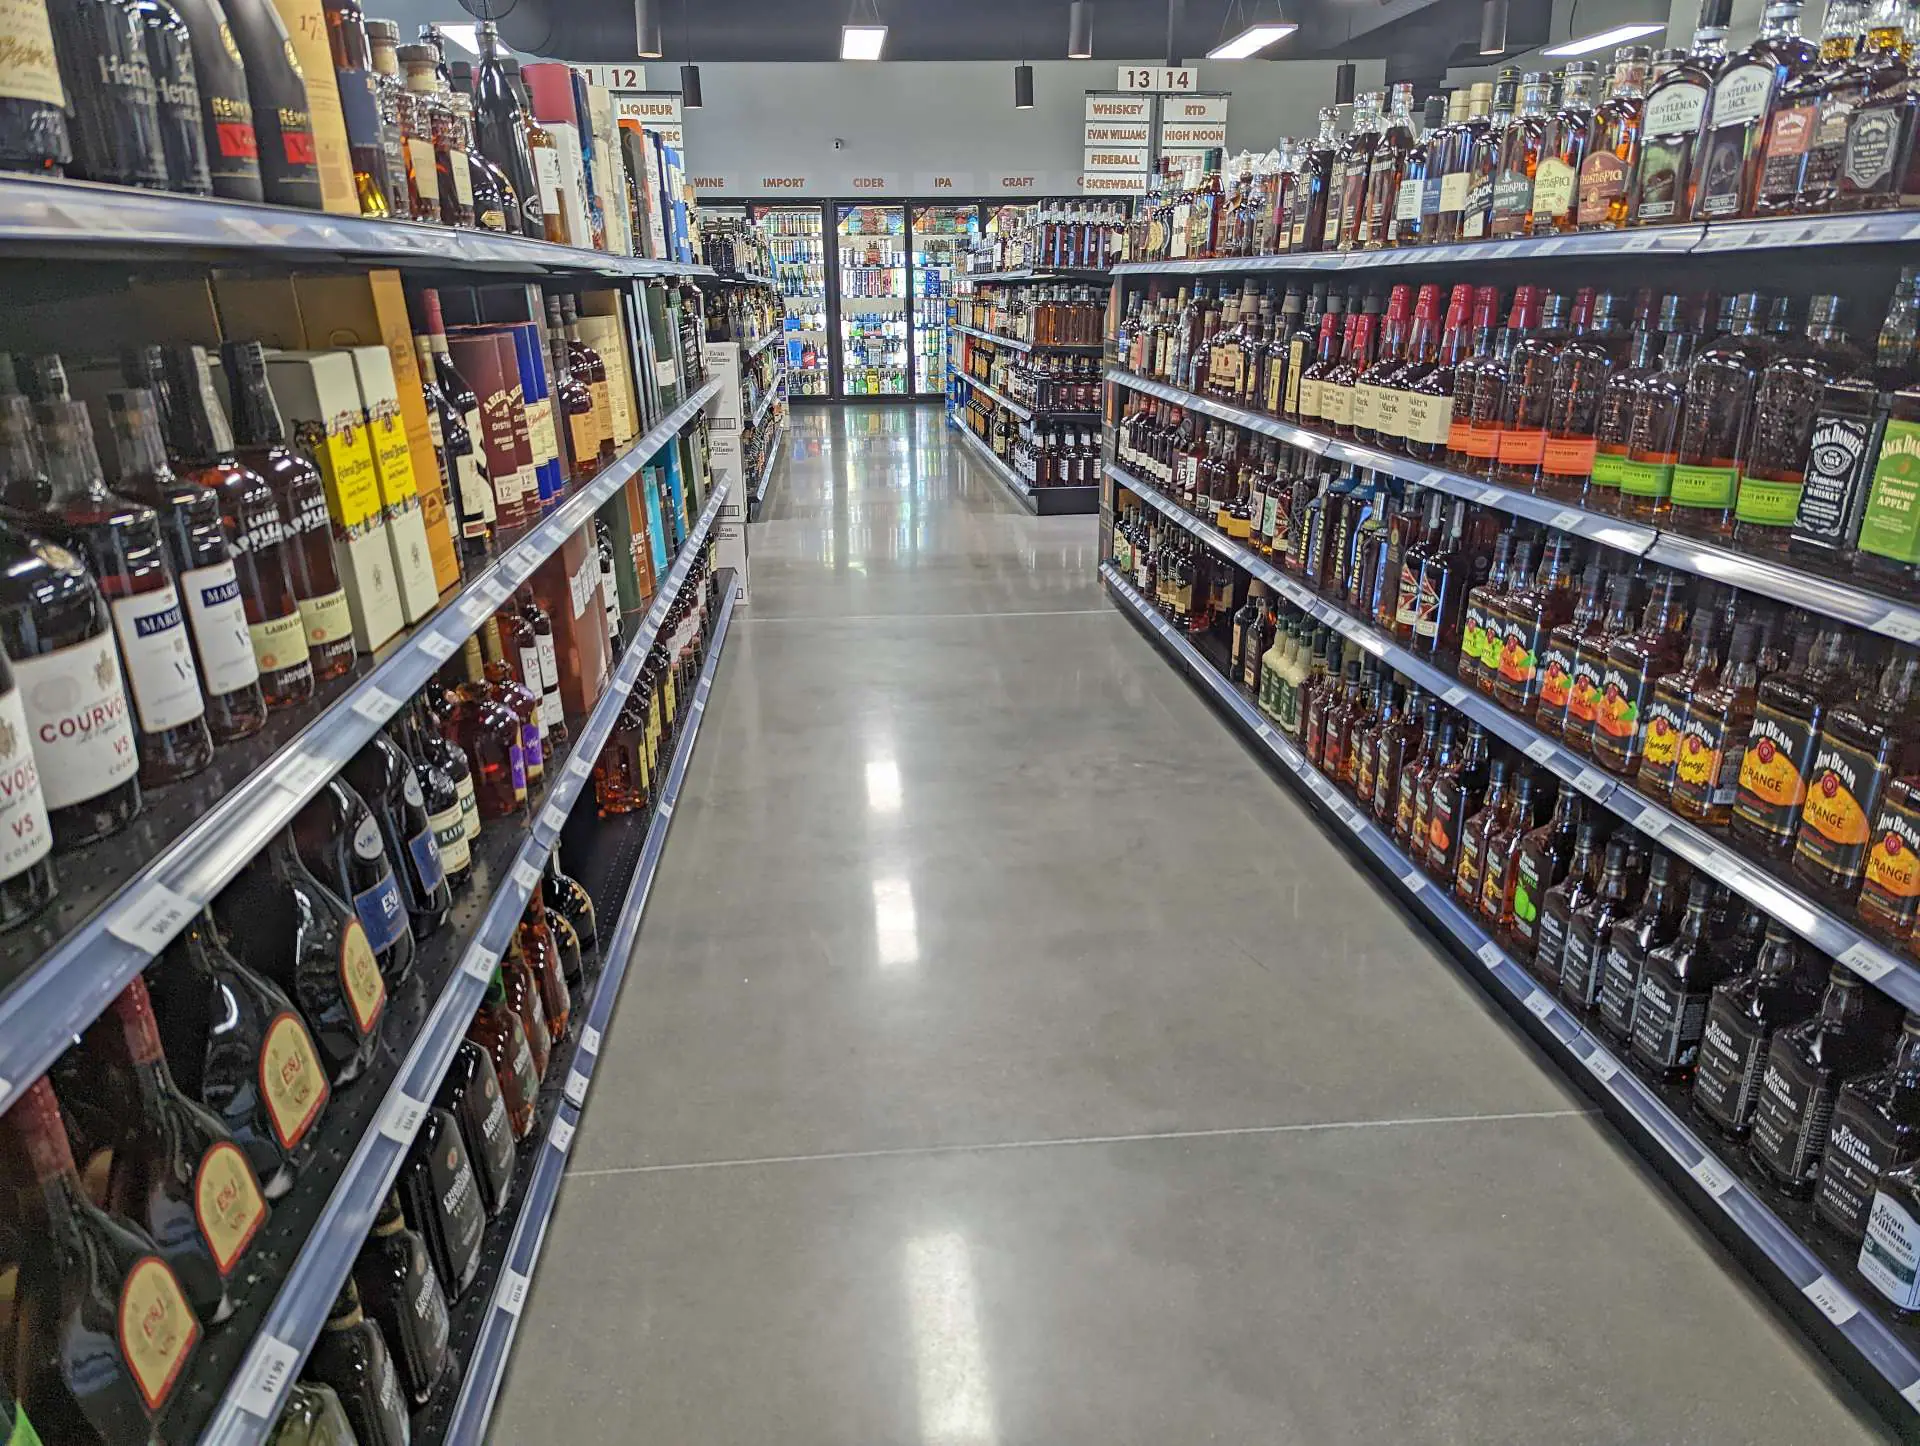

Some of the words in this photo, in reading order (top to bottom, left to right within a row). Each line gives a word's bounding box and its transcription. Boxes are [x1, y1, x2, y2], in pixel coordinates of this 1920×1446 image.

[611, 69, 637, 87] 12
[1127, 70, 1150, 88] 13
[1166, 71, 1189, 88] 14
[1718, 81, 1764, 101] GENTLEMAN
[620, 103, 673, 115] LIQUEUR
[1093, 104, 1144, 115] WHISKEY
[1184, 105, 1206, 115] RTD
[1650, 99, 1699, 116] GENTLEMAN
[1727, 96, 1747, 111] JACK
[1661, 111, 1682, 122] JACK
[1087, 129, 1108, 140] EVAN
[1110, 129, 1147, 141] WILLIAMS
[1165, 131, 1190, 141] HIGH
[1192, 131, 1224, 141] NOON
[1091, 154, 1140, 165] FIREBALL
[694, 178, 724, 188] WINE
[763, 178, 805, 188] IMPORT
[853, 178, 884, 188] CIDER
[934, 178, 952, 188] IPA
[1002, 177, 1034, 188] CRAFT
[1086, 179, 1145, 190] SKREWBALL
[1811, 427, 1832, 450] JACK
[1831, 423, 1864, 459] DANIEL'S
[1880, 437, 1902, 461] JACK
[521, 474, 532, 486] 12
[1809, 470, 1845, 489] Tennessee
[1880, 482, 1917, 501] Tennessee
[500, 486, 511, 498] 12
[1806, 487, 1840, 502] WHISKEY
[1876, 494, 1912, 512] APPLE
[1299, 519, 1310, 564] TINCUP
[1335, 519, 1347, 572] TINCUP
[1352, 546, 1361, 591] TINCUP
[1613, 670, 1629, 697] BEAM
[1649, 702, 1661, 717] JIM
[1660, 703, 1681, 731] BEAM
[1647, 735, 1672, 754] Honey
[1684, 719, 1695, 733] JIM
[1695, 720, 1715, 747] BEAM
[1749, 718, 1767, 738] JIM
[1766, 719, 1793, 756] BEAM
[113, 735, 130, 756] VS
[1681, 754, 1705, 774] Honey
[1814, 750, 1831, 770] JIM
[1830, 751, 1856, 788] BEAM
[1743, 763, 1783, 793] ORANGE
[12, 813, 34, 838] VS
[1805, 798, 1845, 830] ORANGE
[1878, 812, 1894, 831] JIM
[1893, 814, 1920, 850] BEAM
[1867, 854, 1912, 886] ORANGE
[1607, 952, 1634, 982] Williams
[1611, 947, 1628, 968] Evan
[1641, 983, 1673, 1016] Williams
[1646, 977, 1666, 1000] Evan
[1635, 1028, 1660, 1051] BOURBON
[1636, 1017, 1663, 1042] KENTUCKY
[1711, 1020, 1732, 1046] Evan
[1705, 1024, 1740, 1064] Williams
[1699, 1066, 1727, 1094] KENTUCKY
[1699, 1078, 1723, 1104] BOURBON
[1763, 1069, 1798, 1113] Williams
[1769, 1065, 1790, 1094] Evan
[1755, 1126, 1779, 1154] BOURBON
[1756, 1112, 1784, 1144] KENTUCKY
[1831, 1128, 1880, 1175] Williams
[1841, 1124, 1871, 1157] Evan
[1824, 1174, 1863, 1208] KENTUCKY
[1823, 1188, 1858, 1220] BOURBON
[1871, 1210, 1913, 1251] Williams
[1879, 1204, 1905, 1233] Evan
